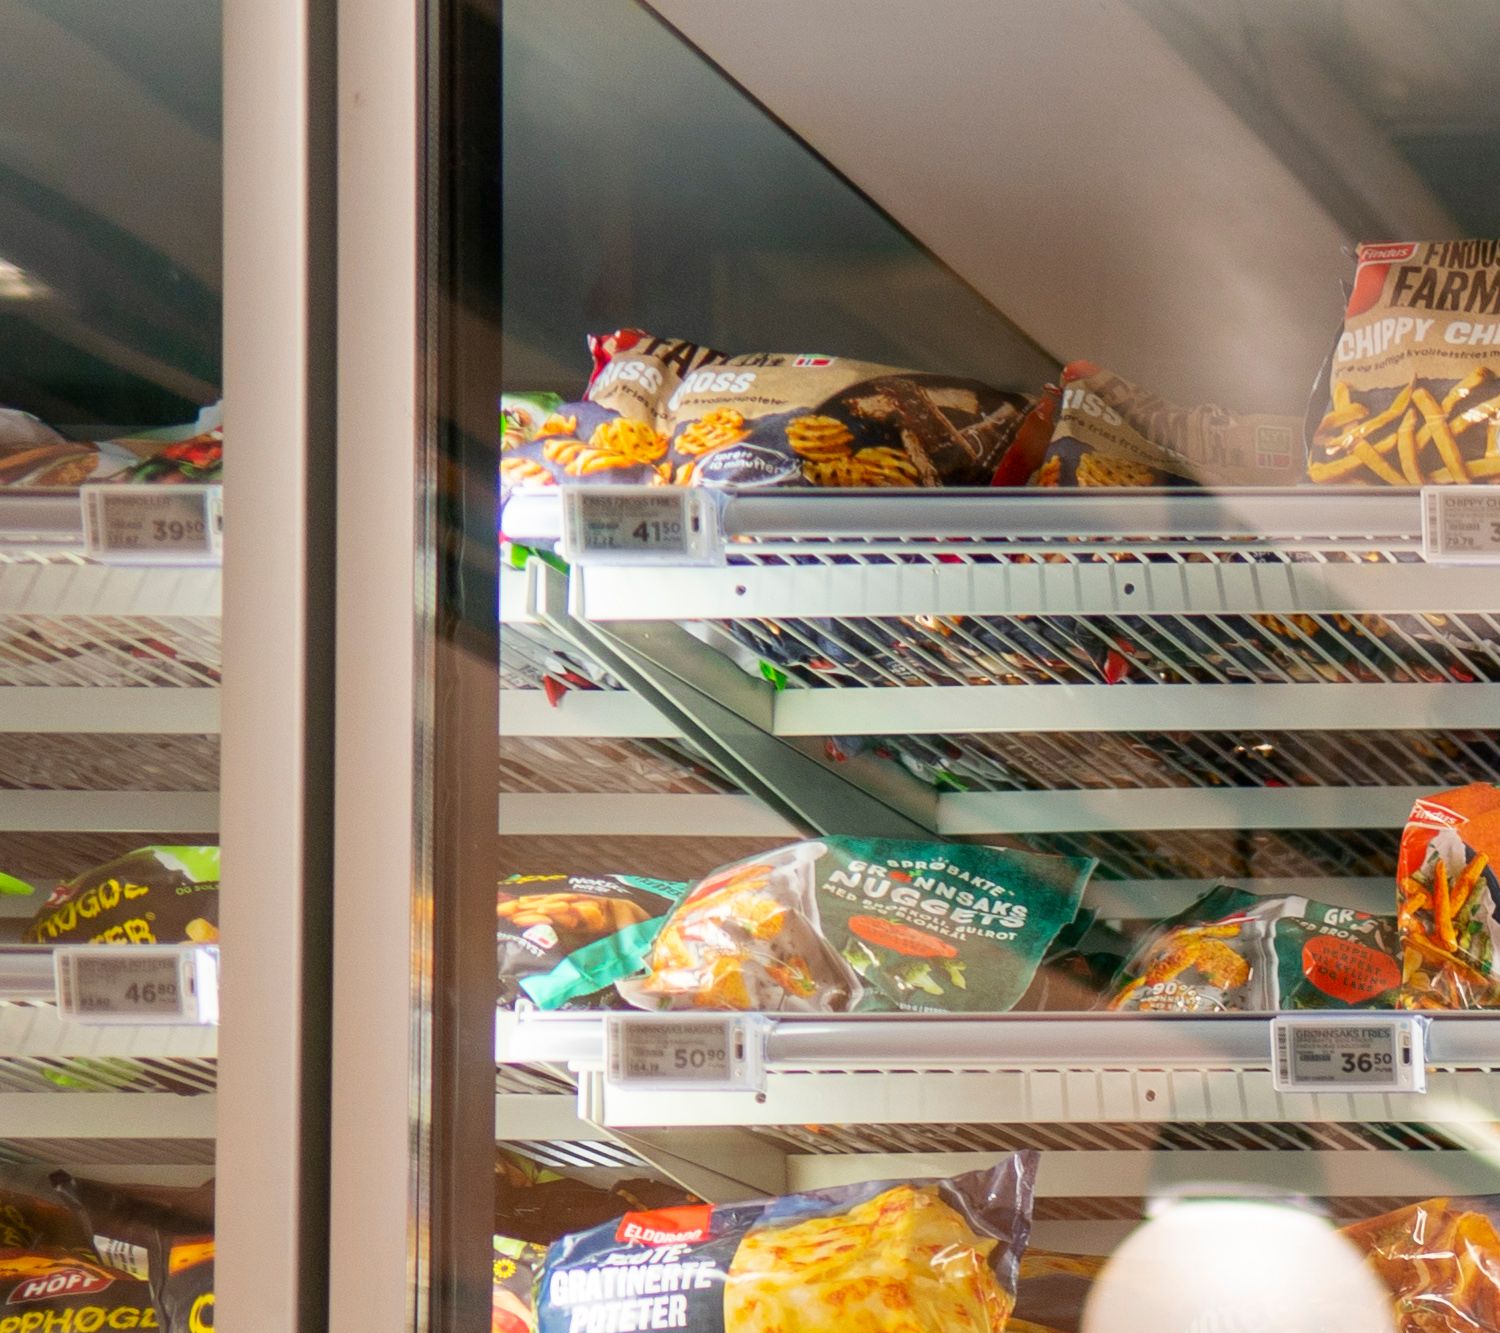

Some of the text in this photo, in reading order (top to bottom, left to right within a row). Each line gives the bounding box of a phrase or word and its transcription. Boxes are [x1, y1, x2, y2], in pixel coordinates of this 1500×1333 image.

[1360, 247, 1410, 260] Findus
[1338, 317, 1435, 362] CHIPPY
[829, 870, 1025, 928] NUGGETS
[550, 1260, 716, 1304] GRATINERTE
